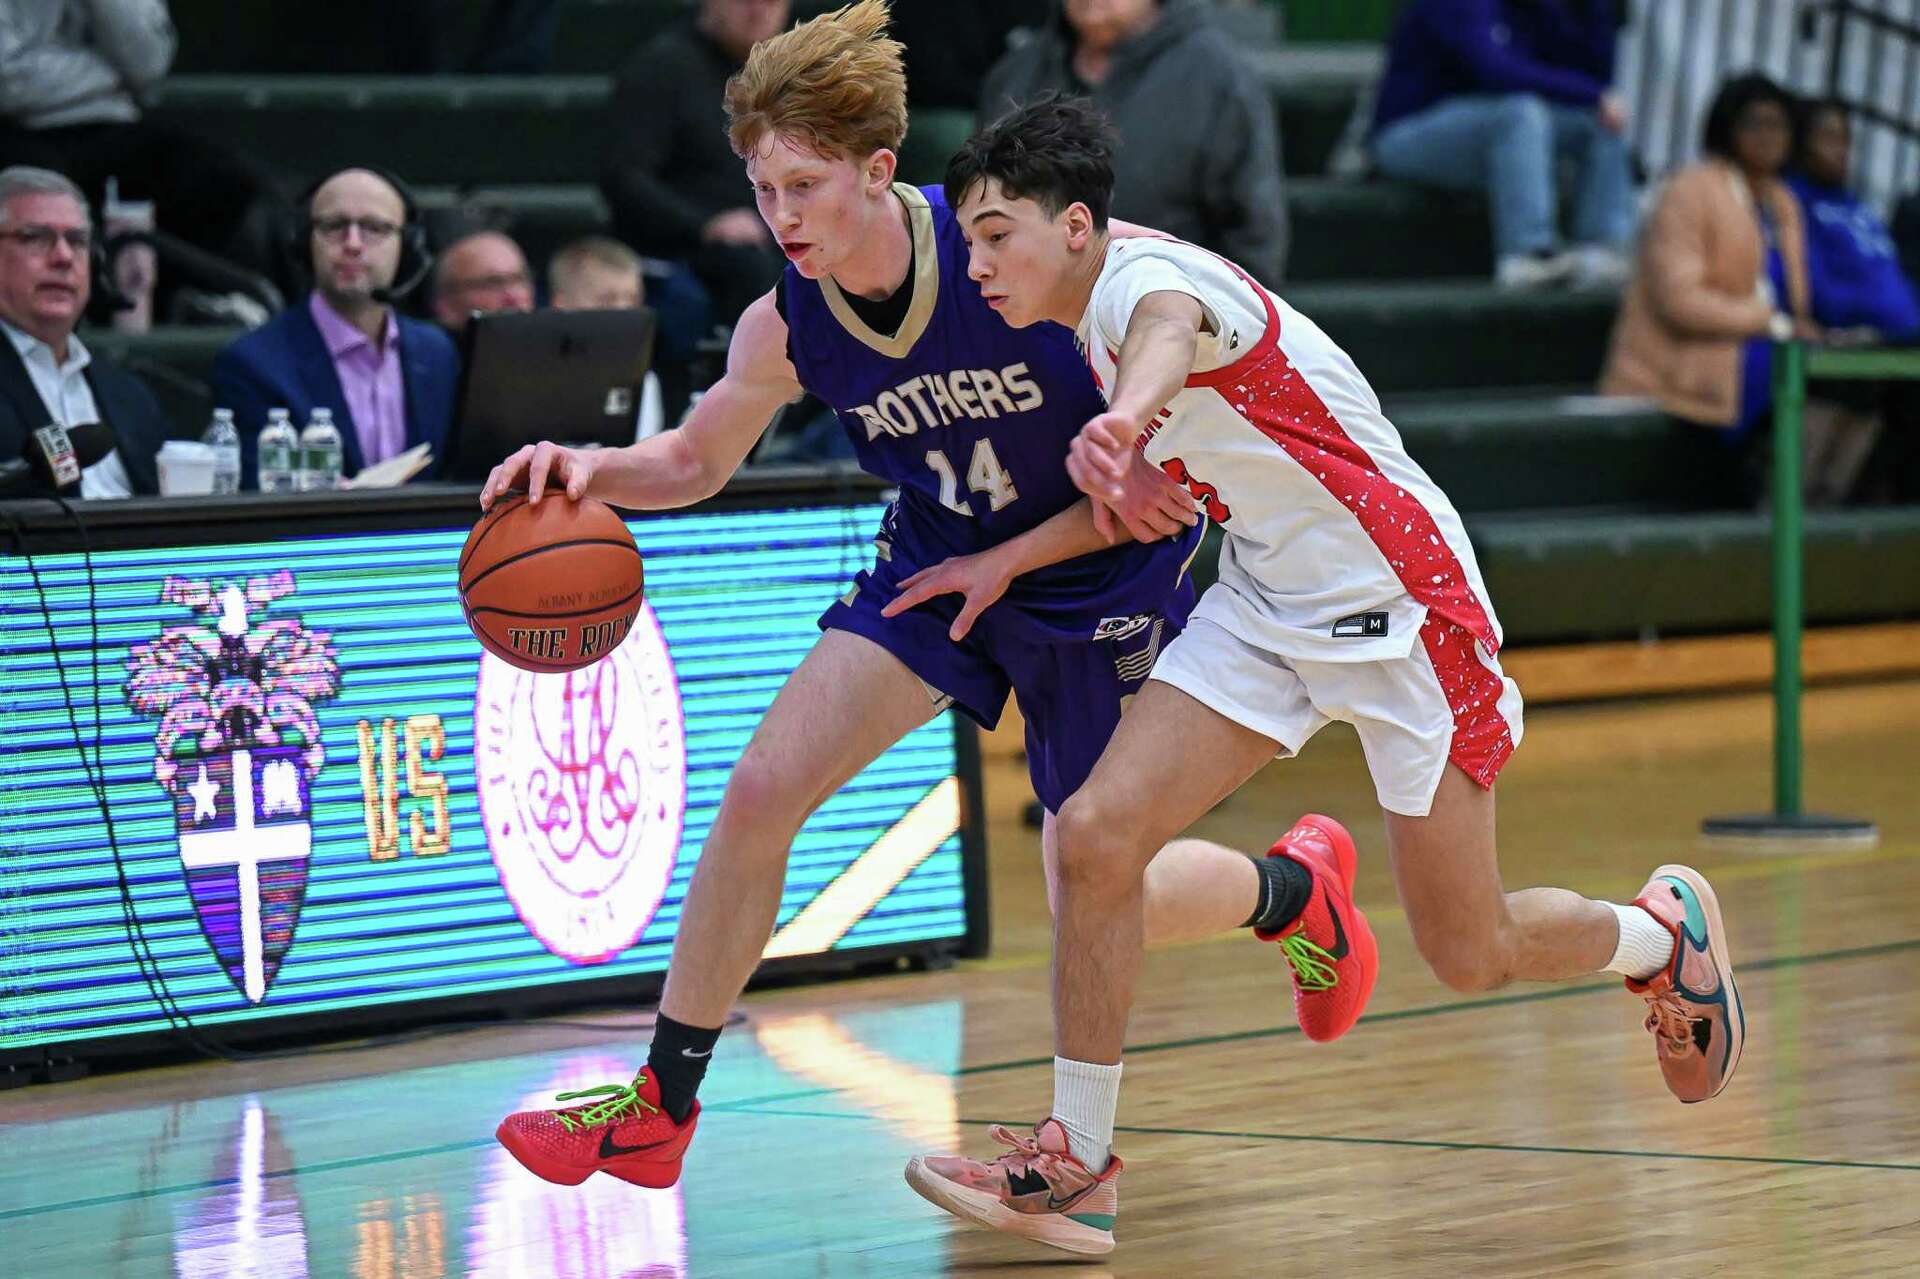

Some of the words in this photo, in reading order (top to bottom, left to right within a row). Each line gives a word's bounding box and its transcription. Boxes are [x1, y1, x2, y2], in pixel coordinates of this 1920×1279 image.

[845, 362, 1043, 441] ROTHERS
[925, 438, 1019, 517] 14
[508, 628, 568, 658] THE
[1370, 619, 1381, 629] M
[356, 714, 452, 863] VS
